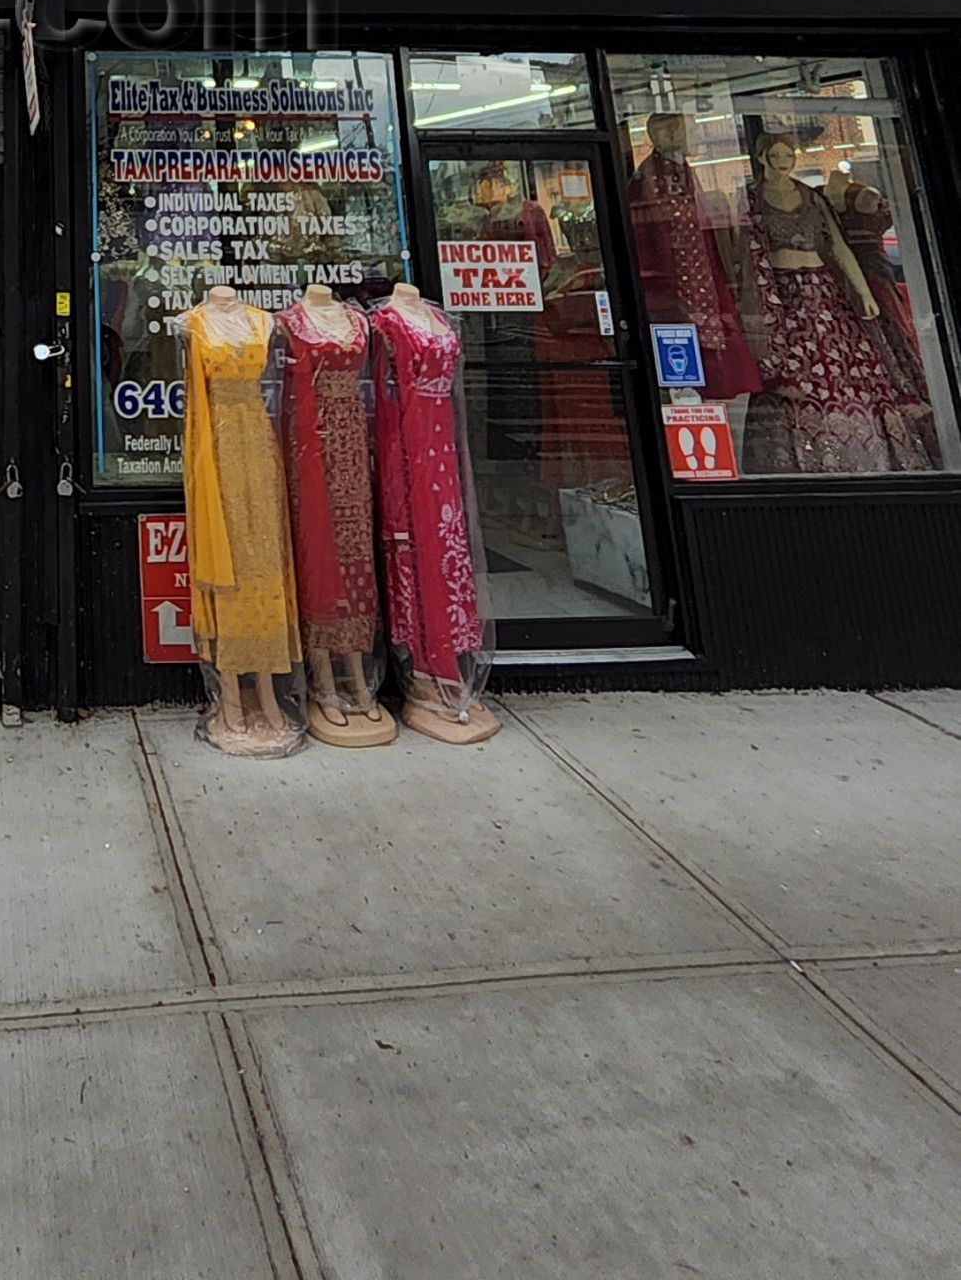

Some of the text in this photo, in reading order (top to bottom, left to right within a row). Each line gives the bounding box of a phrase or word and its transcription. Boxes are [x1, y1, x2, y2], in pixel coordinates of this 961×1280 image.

[110, 79, 375, 114] Elite Tax & Business Solutions Inc
[112, 149, 383, 183] TAX PREPARATION SERVICES
[159, 192, 296, 212] INDIVIDUAL TAXES
[159, 217, 358, 236] CORPORATION TAXES
[159, 241, 270, 261] SALES TAX
[440, 244, 533, 263] INCOME
[305, 264, 363, 284] TAXES
[453, 268, 527, 288] TAX
[162, 291, 193, 310] TAX
[450, 292, 536, 306] DONE HERE
[124, 435, 172, 455] Federally
[117, 457, 161, 474] Taxation
[146, 522, 186, 562] EZ
